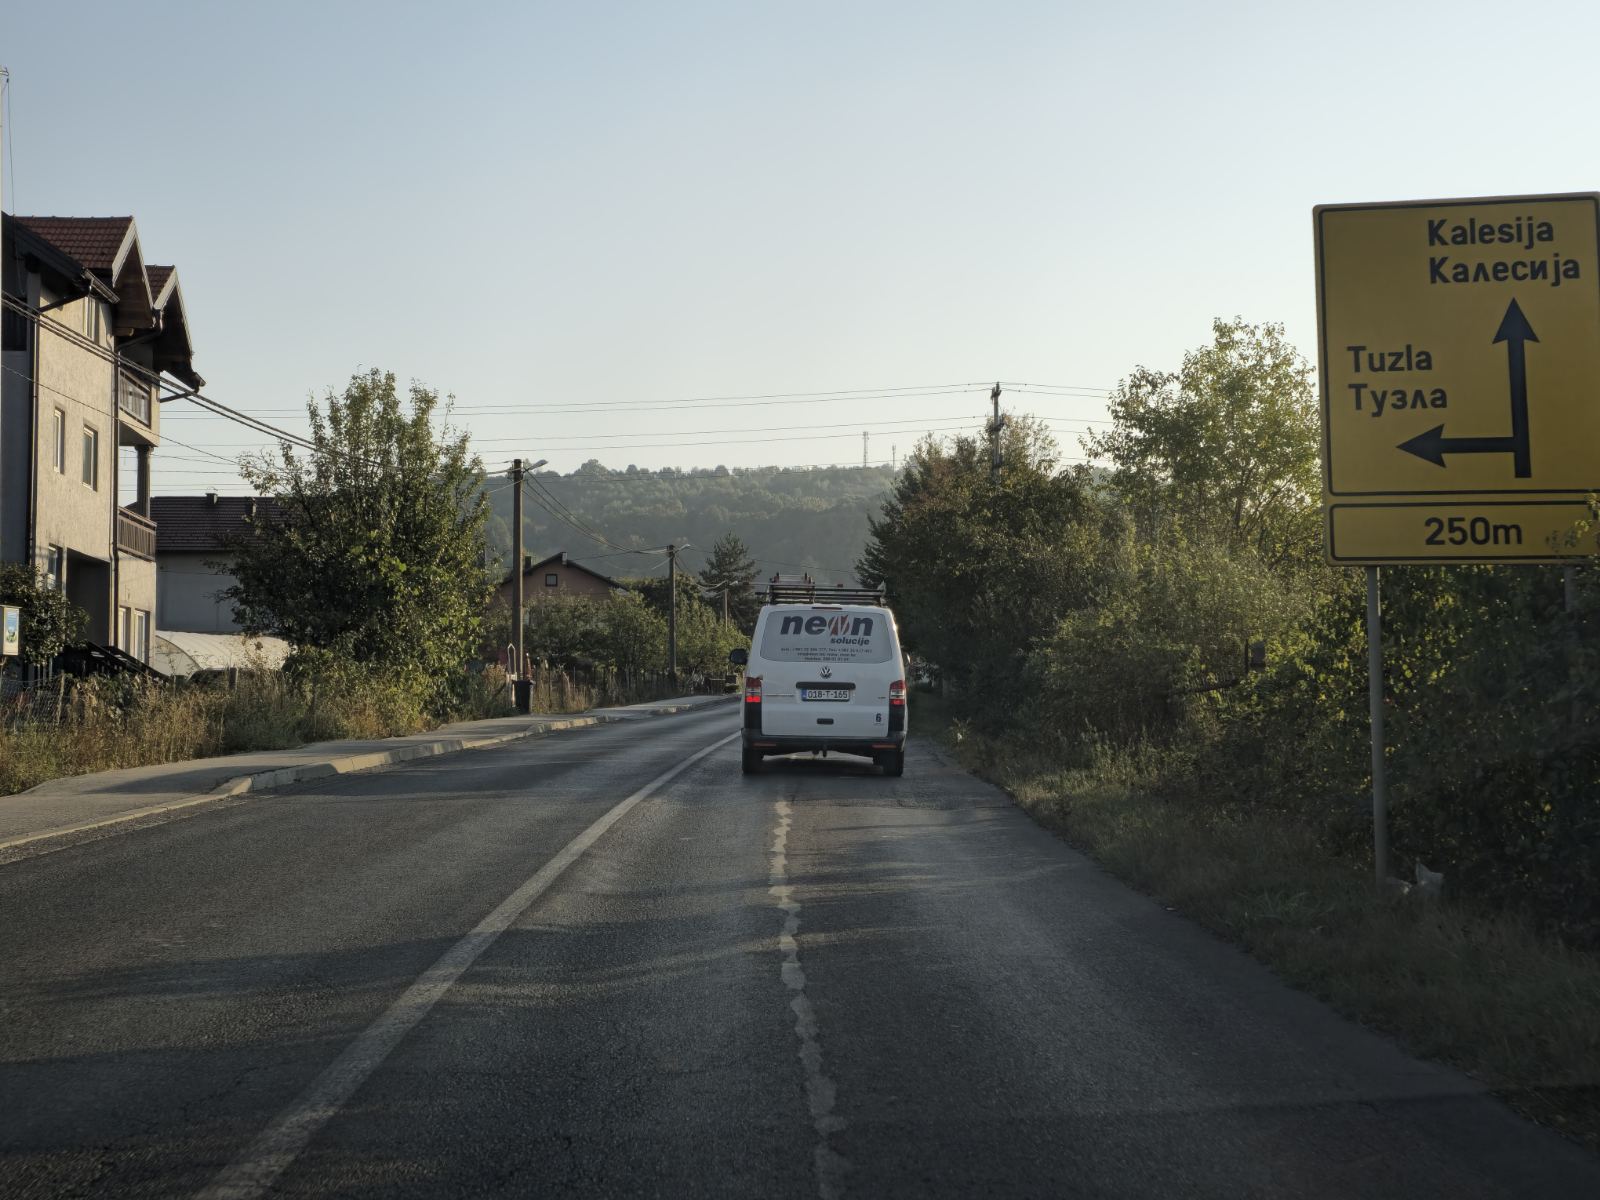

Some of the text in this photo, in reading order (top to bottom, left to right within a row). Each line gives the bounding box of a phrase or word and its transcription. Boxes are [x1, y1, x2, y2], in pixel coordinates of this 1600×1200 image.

[1427, 216, 1554, 250] Kalesija
[1429, 253, 1580, 287] Калесија
[1347, 344, 1433, 373] Tuzla
[1348, 383, 1448, 418] Тузла
[1424, 516, 1522, 546] 250m
[830, 636, 870, 647] solucije
